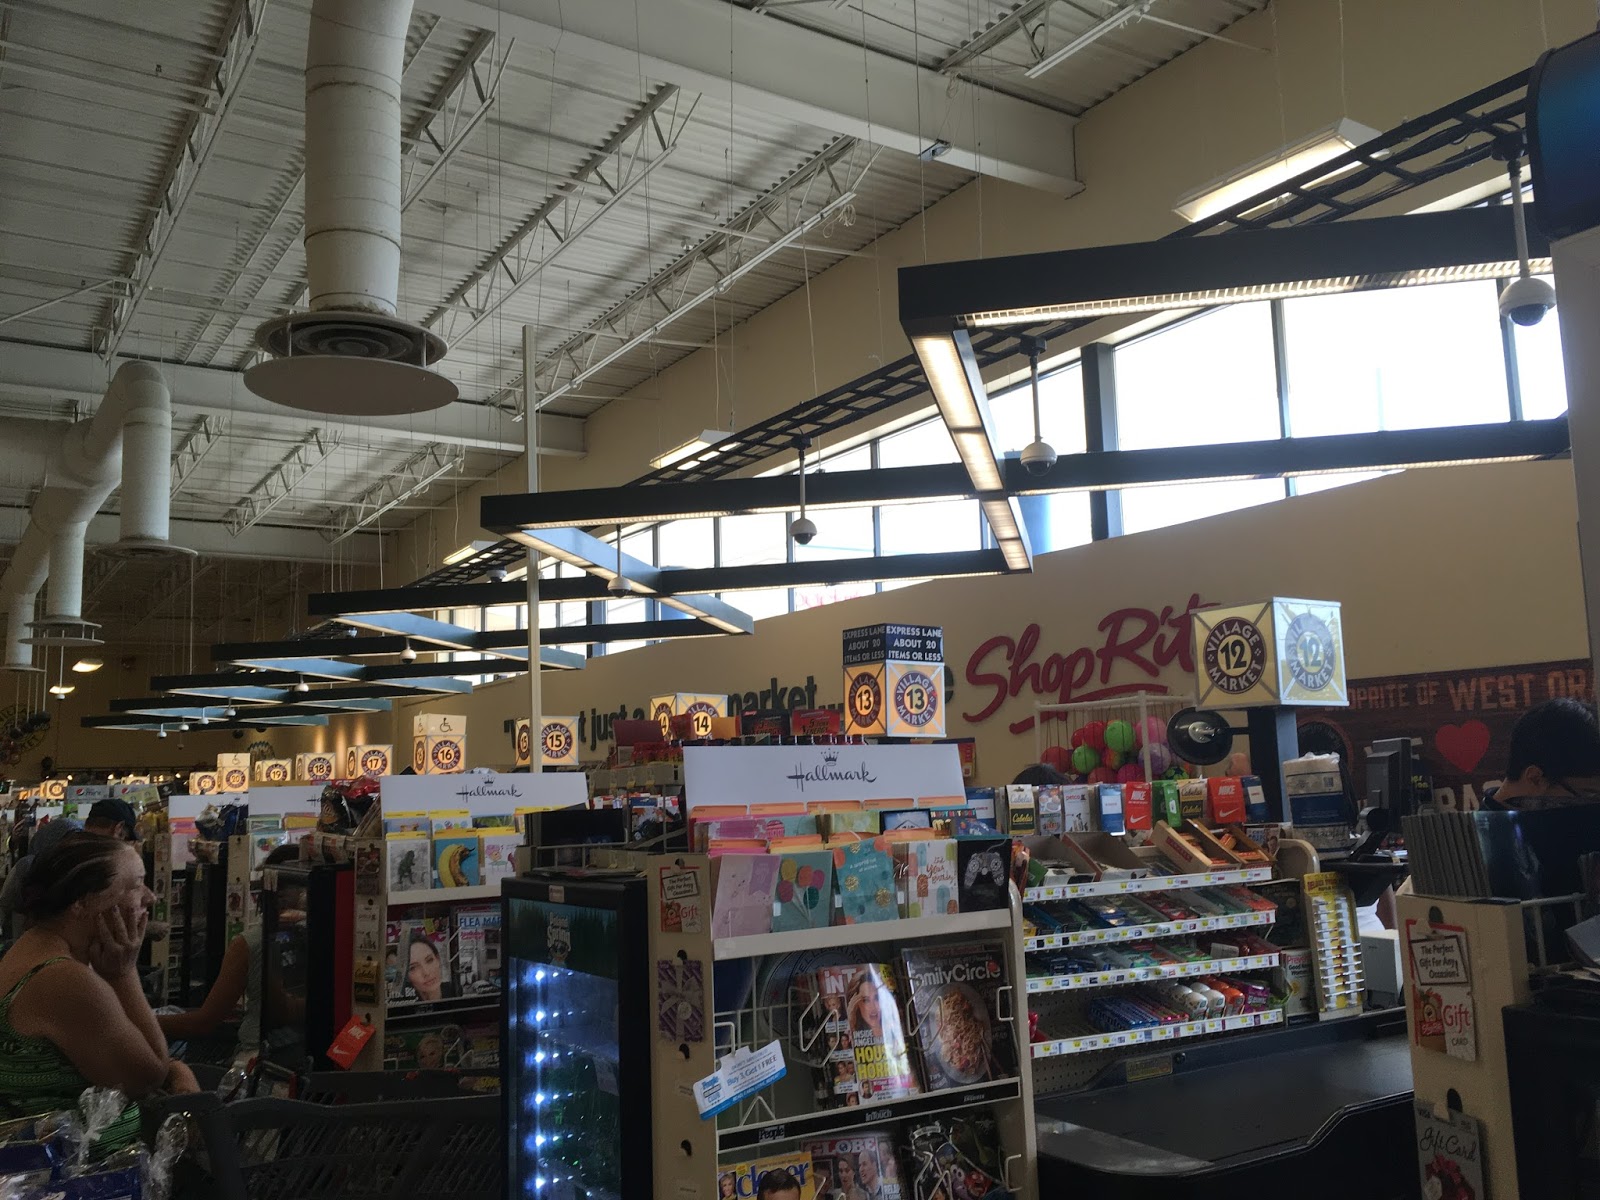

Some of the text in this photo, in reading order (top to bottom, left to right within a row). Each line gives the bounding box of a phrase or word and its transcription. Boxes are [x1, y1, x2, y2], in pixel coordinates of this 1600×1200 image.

[843, 625, 885, 640] EXPRESS LANE
[886, 625, 942, 638] EXPRESS LANE
[1206, 620, 1260, 652] VILLAGE
[848, 639, 881, 651] ABOUT 20
[893, 638, 937, 649] ABOUT 20
[844, 650, 885, 662] ITEMS OR LESS
[888, 650, 942, 661] ITEMS OR LESS
[962, 593, 1197, 723] ShopRit
[1219, 639, 1247, 670] 12
[1299, 636, 1322, 667] 12
[1209, 660, 1262, 691] MARKET
[1290, 660, 1333, 688] MARKET
[850, 675, 878, 696] VILLAGE
[896, 674, 934, 694] VILLAGE
[1347, 669, 1587, 711] OPRITE OF WEST OR
[857, 688, 872, 711] 13
[906, 688, 925, 710] 13
[850, 704, 878, 724] MARKET
[897, 704, 934, 725] MARKET
[693, 715, 710, 732] 14
[541, 724, 570, 738] VILLAGE
[433, 741, 459, 754] VILLAGE
[548, 734, 562, 748] 15
[439, 749, 452, 761] 16
[541, 745, 570, 758] MARKET
[314, 764, 325, 774] 18
[368, 758, 380, 769] 17
[433, 757, 459, 769] MARKET
[272, 770, 281, 779] 19
[786, 761, 877, 792] Hallmark
[455, 784, 523, 803] Hallmark
[1131, 790, 1146, 801] NIKE
[1218, 785, 1236, 796] NIKE
[681, 904, 698, 920] Gift
[460, 917, 480, 928] FLEA
[1420, 944, 1454, 957] The Perfect
[1419, 957, 1456, 970] Gift For Any
[1443, 1003, 1471, 1034] Gift
[853, 1029, 874, 1038] INSIDE
[1451, 1036, 1468, 1047] CARD
[727, 1075, 739, 1086] Buy
[745, 1067, 758, 1077] Get
[761, 1054, 777, 1068] FREE
[865, 1109, 893, 1122] InTouch
[760, 1126, 785, 1141] People
[1446, 1135, 1477, 1162] Card
